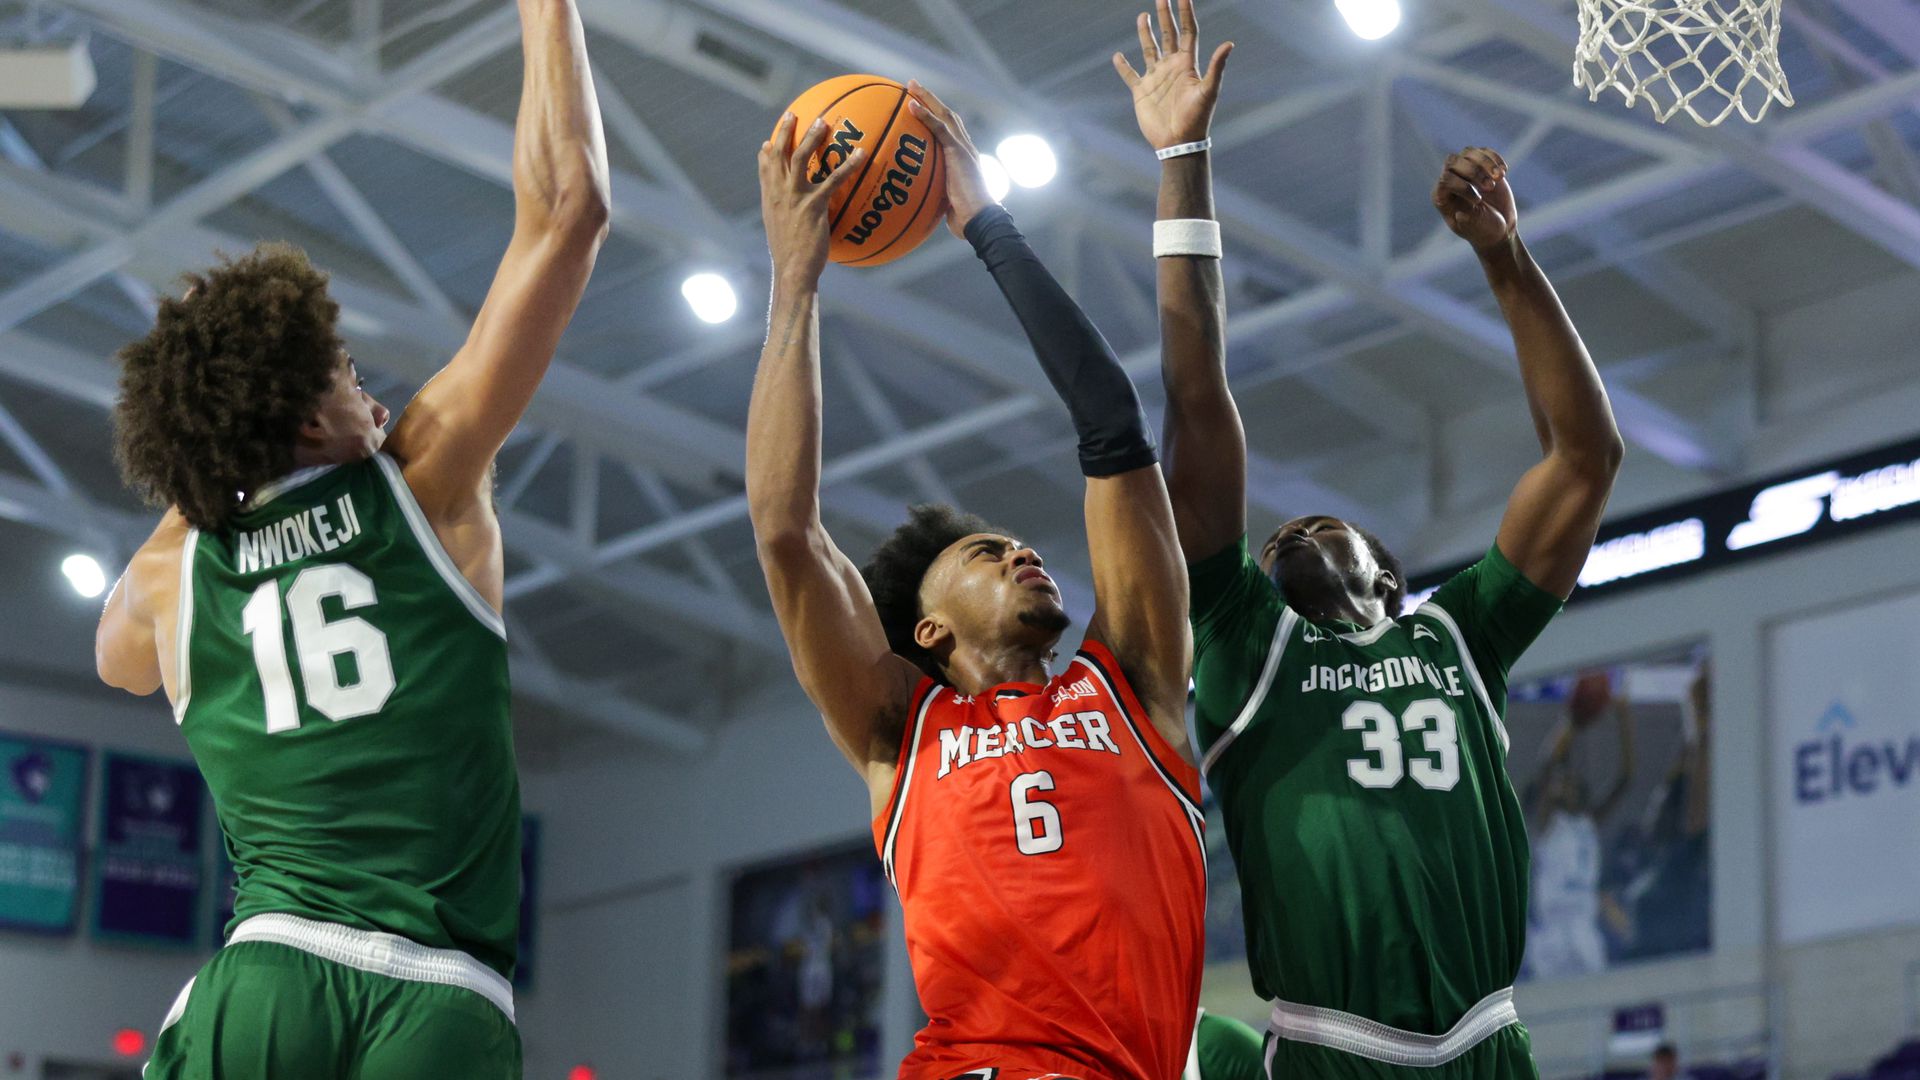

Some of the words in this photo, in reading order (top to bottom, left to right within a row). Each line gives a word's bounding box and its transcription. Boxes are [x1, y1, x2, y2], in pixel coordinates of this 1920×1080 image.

[843, 133, 928, 246] Wilson
[239, 493, 362, 575] NWOKEJI
[241, 561, 398, 735] 16
[1301, 655, 1465, 697] JACKSONLE
[936, 709, 1121, 781] MERCER
[1341, 697, 1461, 792] 33
[1009, 769, 1065, 857] 6
